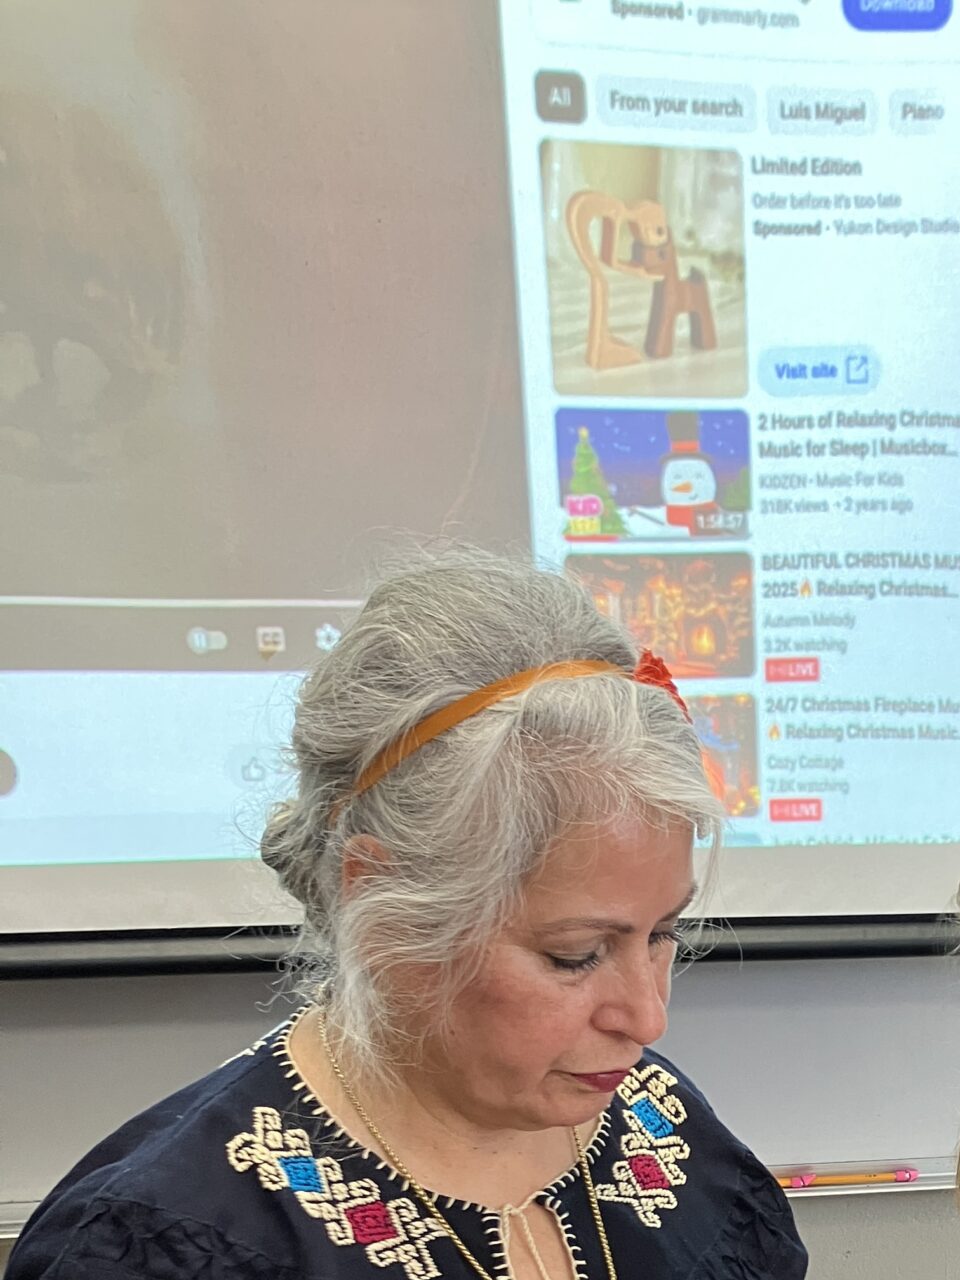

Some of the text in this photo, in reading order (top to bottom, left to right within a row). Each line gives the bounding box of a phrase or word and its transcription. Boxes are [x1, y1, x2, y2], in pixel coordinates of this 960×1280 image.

[697, 5, 800, 31] grammarly.com
[550, 86, 571, 107] All
[609, 91, 743, 118] From your search
[780, 101, 866, 126] Luis Miguel
[901, 102, 944, 121] Piano
[751, 155, 862, 177] Limited Edition
[752, 191, 902, 210] Order before too late
[753, 217, 960, 238] Sponsored Yukon Design Studio
[775, 362, 838, 380] Visit site
[757, 412, 769, 431] 2
[772, 412, 814, 430] Hours
[817, 410, 834, 429] of
[837, 409, 896, 432] Relaxing
[758, 439, 870, 460] Music for Sleep
[758, 471, 852, 490] KIDZEN Music
[855, 497, 888, 515] years
[762, 553, 841, 572] BEAUTIFUL
[844, 553, 931, 571] CHRISTMAS
[762, 579, 876, 601] 2025 Relaxing
[813, 612, 857, 631] Melody
[793, 636, 848, 655] watching
[765, 697, 798, 714] 24/7
[801, 697, 870, 714] Christmas
[874, 697, 936, 716] Fireplace
[785, 723, 916, 744] Relaxing Christmas
[767, 754, 845, 773] Cozy Cottage
[797, 778, 850, 795] watching
